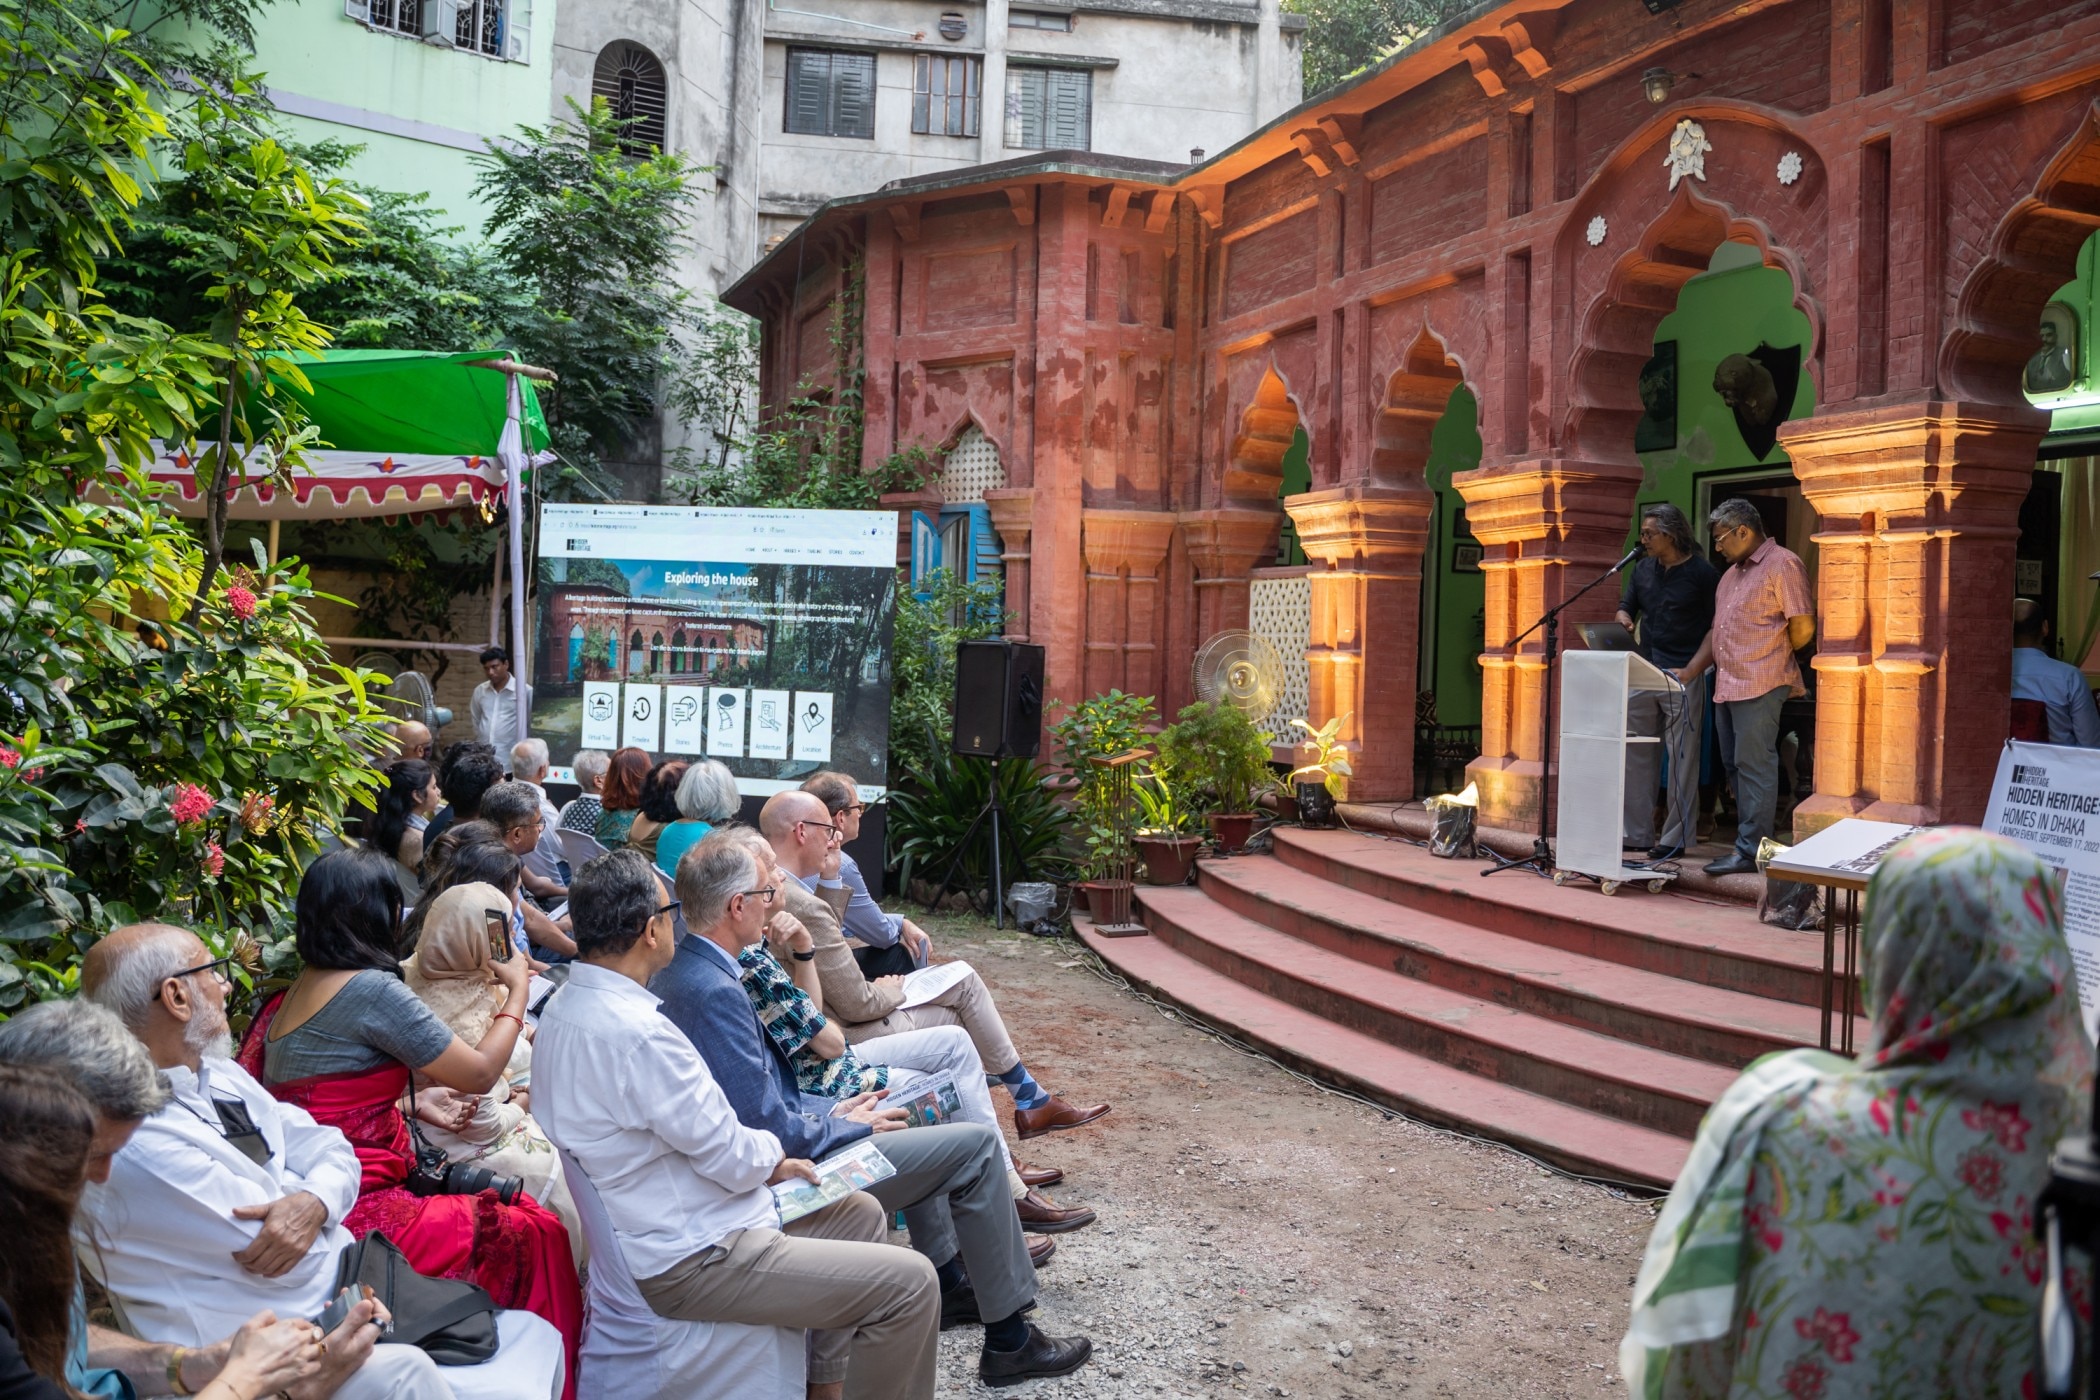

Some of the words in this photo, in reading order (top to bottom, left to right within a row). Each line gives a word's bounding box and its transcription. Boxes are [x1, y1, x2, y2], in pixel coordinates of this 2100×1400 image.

[664, 571, 711, 587] Exploring
[711, 572, 728, 585] the
[729, 572, 759, 586] house
[806, 602, 821, 611] history
[685, 621, 702, 630] features
[632, 735, 650, 743] Timeline
[675, 738, 690, 746] Stories
[755, 743, 782, 752] Architecture
[802, 745, 821, 753] Location
[2024, 765, 2047, 777] HIDDEN
[2023, 775, 2050, 788] HERITAGE
[2006, 786, 2045, 807] HIDDEN
[2045, 791, 2100, 815] HERITAGE:
[2002, 806, 2037, 828] HOMES
[2037, 812, 2050, 830] IN
[2050, 814, 2085, 837] DHAKA
[1998, 825, 2020, 838] LAUNCH
[2020, 829, 2039, 843] EVENT,
[2039, 832, 2074, 848] SEPTEMBER
[2074, 839, 2083, 851] 17,
[2083, 840, 2100, 853] 2022
[885, 1092, 902, 1103] HIDDEN
